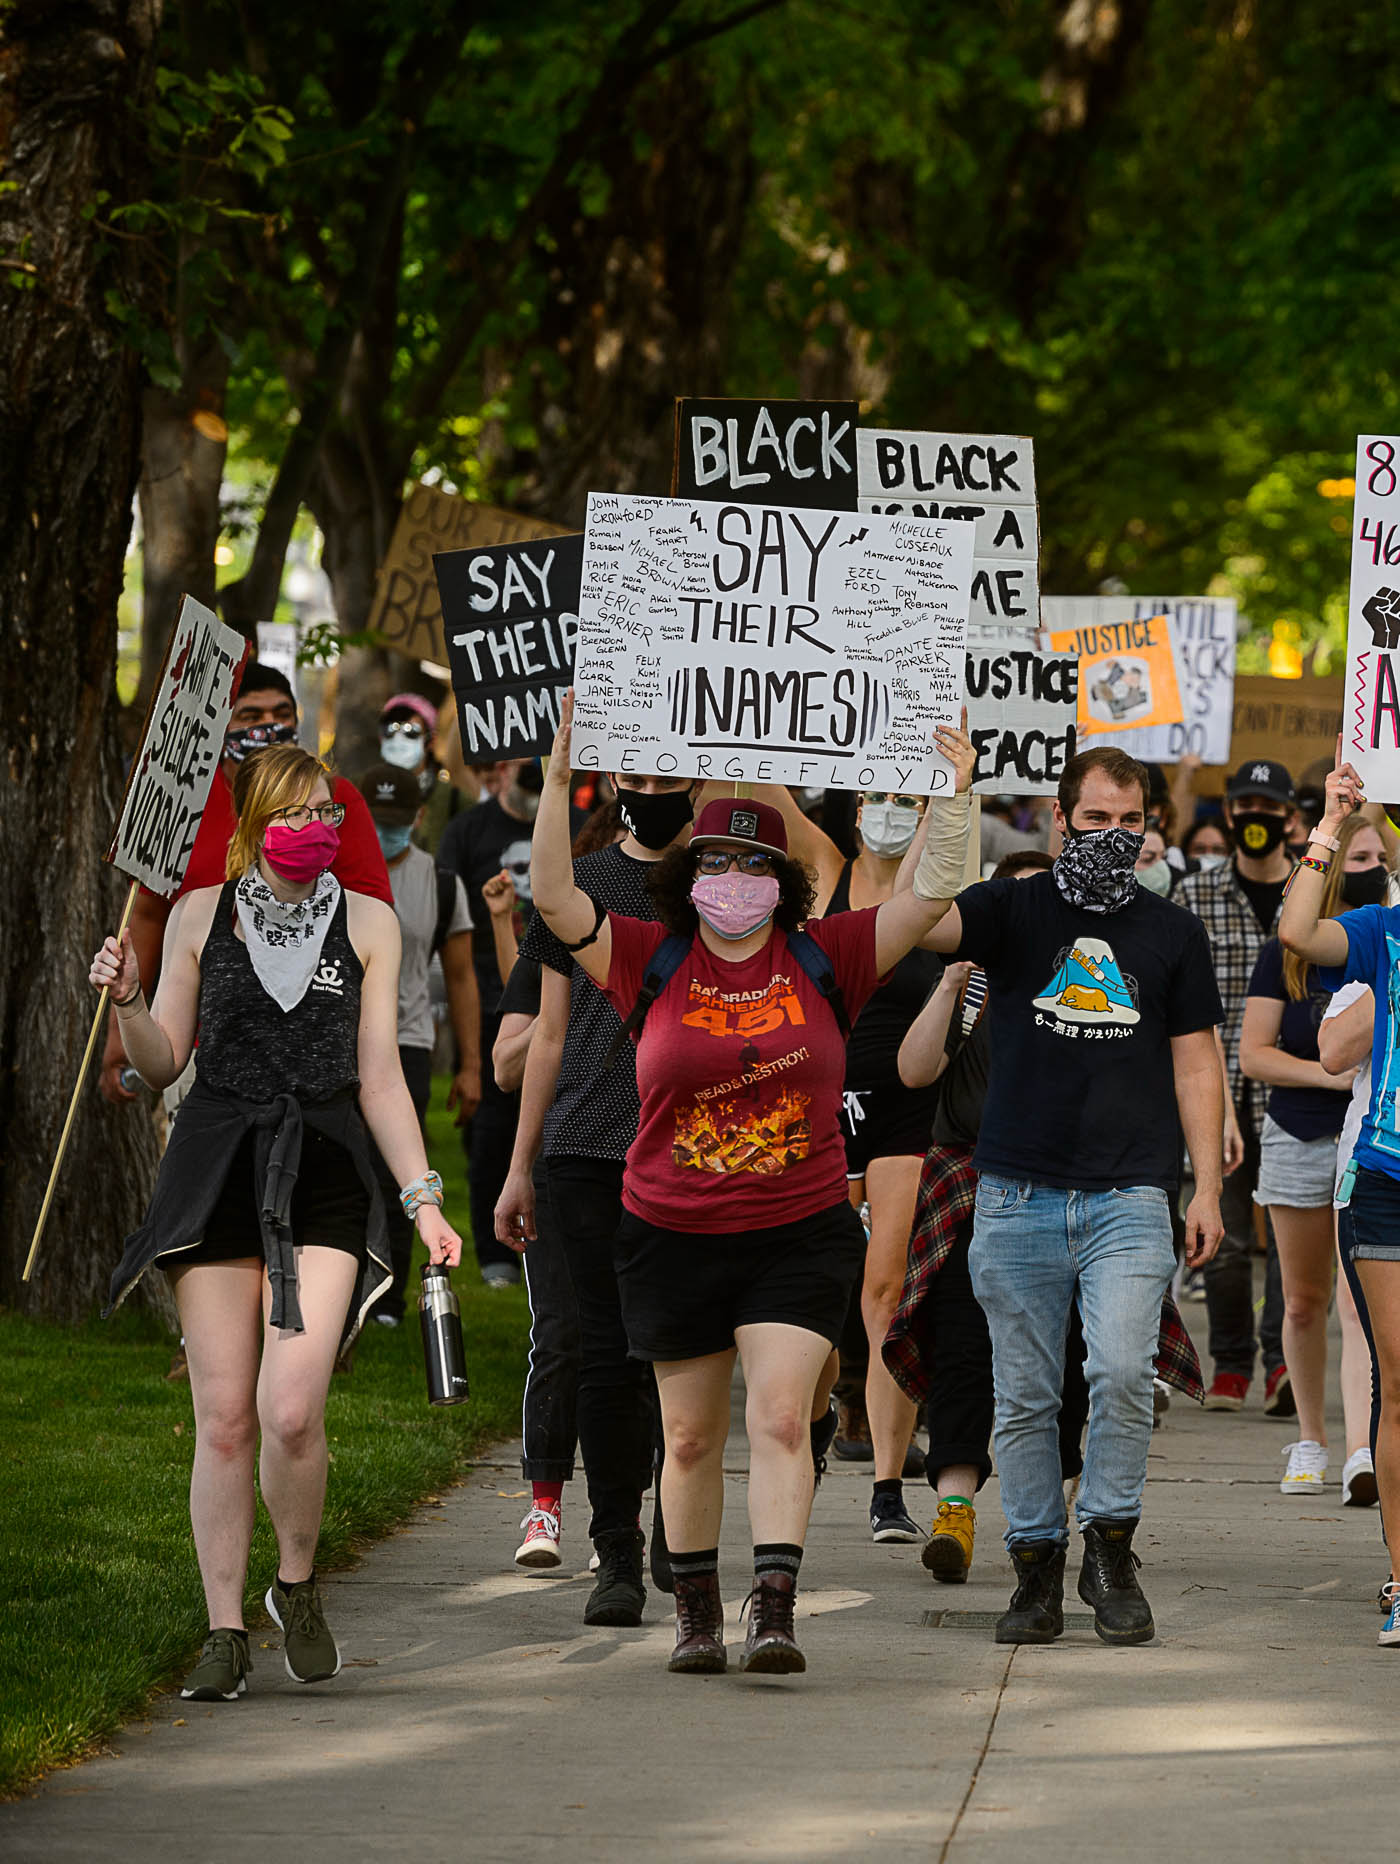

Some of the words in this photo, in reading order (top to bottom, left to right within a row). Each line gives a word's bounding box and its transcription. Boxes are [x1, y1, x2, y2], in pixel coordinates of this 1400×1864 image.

[692, 406, 851, 490] BLACK
[876, 438, 1021, 492] BLACK
[1366, 440, 1397, 496] 8
[589, 497, 619, 511] JOHN
[632, 498, 664, 509] George
[889, 521, 948, 538] MICHELLE
[993, 510, 1025, 549] A
[713, 506, 840, 602] SAY
[895, 537, 953, 557] CUSSEAUX
[864, 549, 906, 562] MATTHEW
[585, 560, 620, 570] TAMIR
[636, 560, 684, 591] BROWN
[848, 566, 887, 581] EZEL
[904, 568, 944, 580] Natasha
[468, 549, 555, 614] SAY
[844, 578, 881, 595] FORD
[892, 585, 917, 600] TONY
[603, 590, 641, 616] ERIC
[904, 597, 948, 610] ROBINSON
[597, 607, 653, 647] GARNER
[678, 597, 836, 655] THEIR
[939, 624, 964, 633] WHITE
[581, 635, 623, 646] BRENDON
[1070, 618, 1159, 657] JUSTICE
[596, 645, 627, 654] GLENN
[844, 645, 873, 655] DOMINIC
[884, 637, 933, 664] DANTE
[579, 657, 615, 671] JAMAR
[895, 651, 951, 674] PARKER
[579, 669, 614, 685] CLARK
[891, 677, 909, 689] ERIC
[966, 651, 1079, 704] USTICE
[581, 684, 623, 697] JANET
[929, 680, 953, 692] MYA
[893, 689, 921, 701] HARRIS
[935, 692, 961, 702] HALL
[603, 698, 653, 709] WILSON
[695, 667, 857, 747] NAMES
[573, 720, 607, 730] MARCO
[612, 723, 641, 733] LOUD
[607, 732, 630, 742] PAUL
[900, 754, 923, 763] JEAN
[972, 724, 1077, 784] EACE!
[578, 744, 773, 779] GEORGE
[799, 762, 948, 791] FLOYD
[123, 774, 205, 882] VIOLENCE
[690, 983, 719, 997] RAY
[681, 994, 807, 1038] 451
[1083, 1027, 1133, 1039] かえりたい
[741, 1046, 811, 1085] DESTROY!
